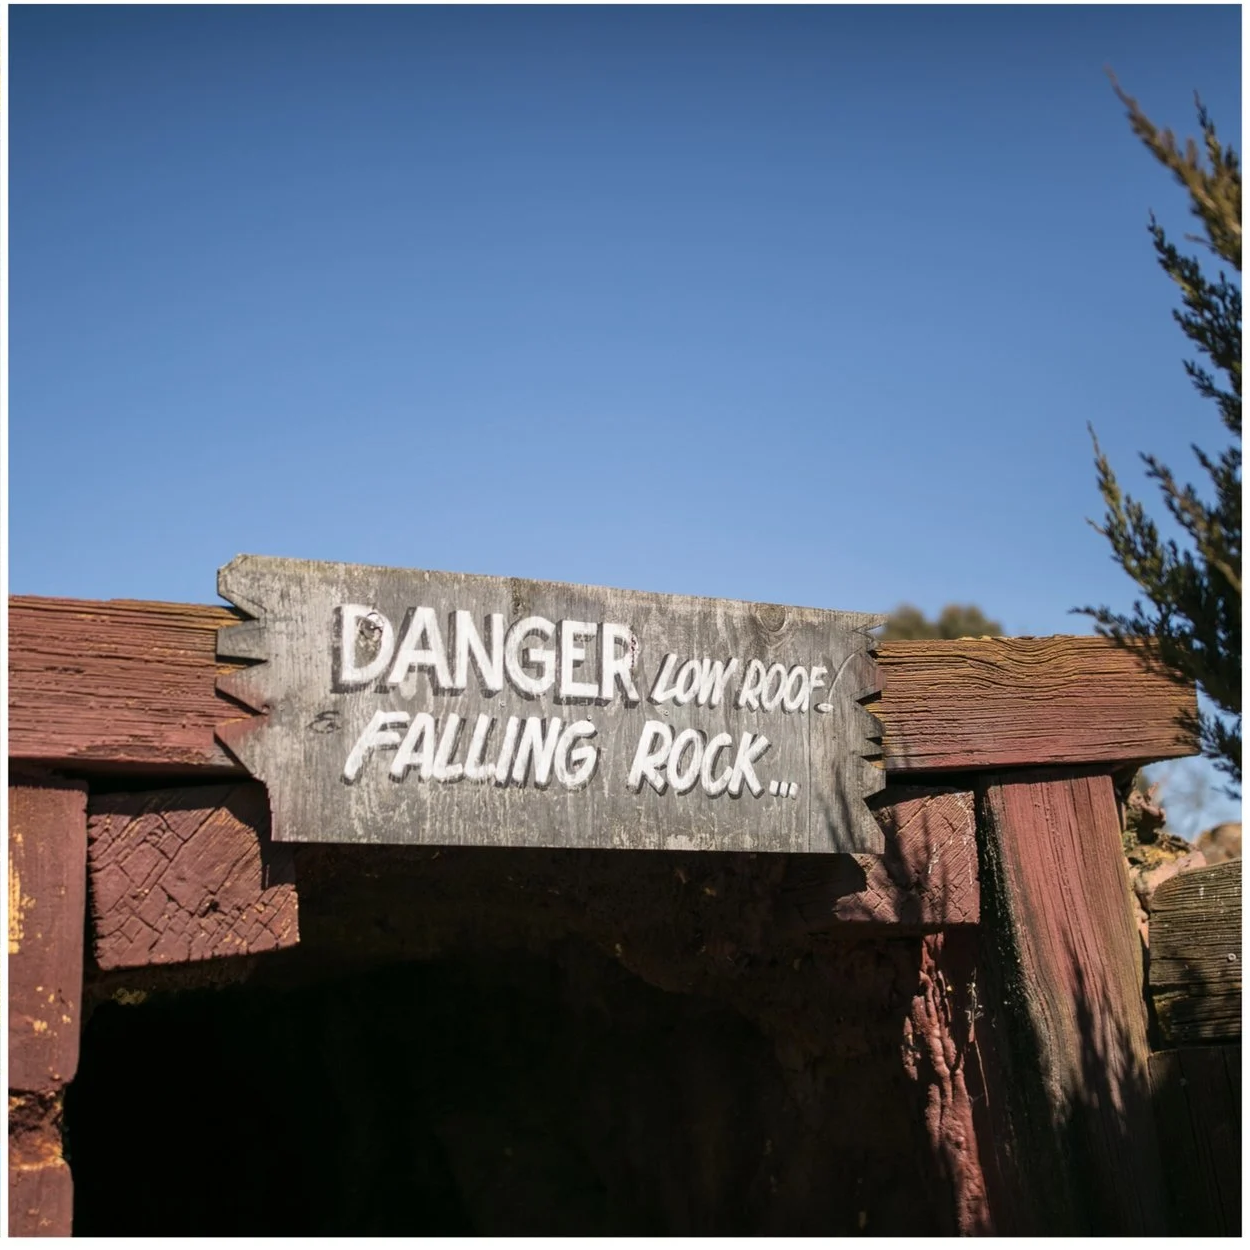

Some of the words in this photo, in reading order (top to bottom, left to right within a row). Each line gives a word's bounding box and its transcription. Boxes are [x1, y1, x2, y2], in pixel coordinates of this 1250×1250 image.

[332, 603, 640, 708] DANGER
[649, 653, 738, 707] LOW
[341, 710, 598, 792] FALLING
